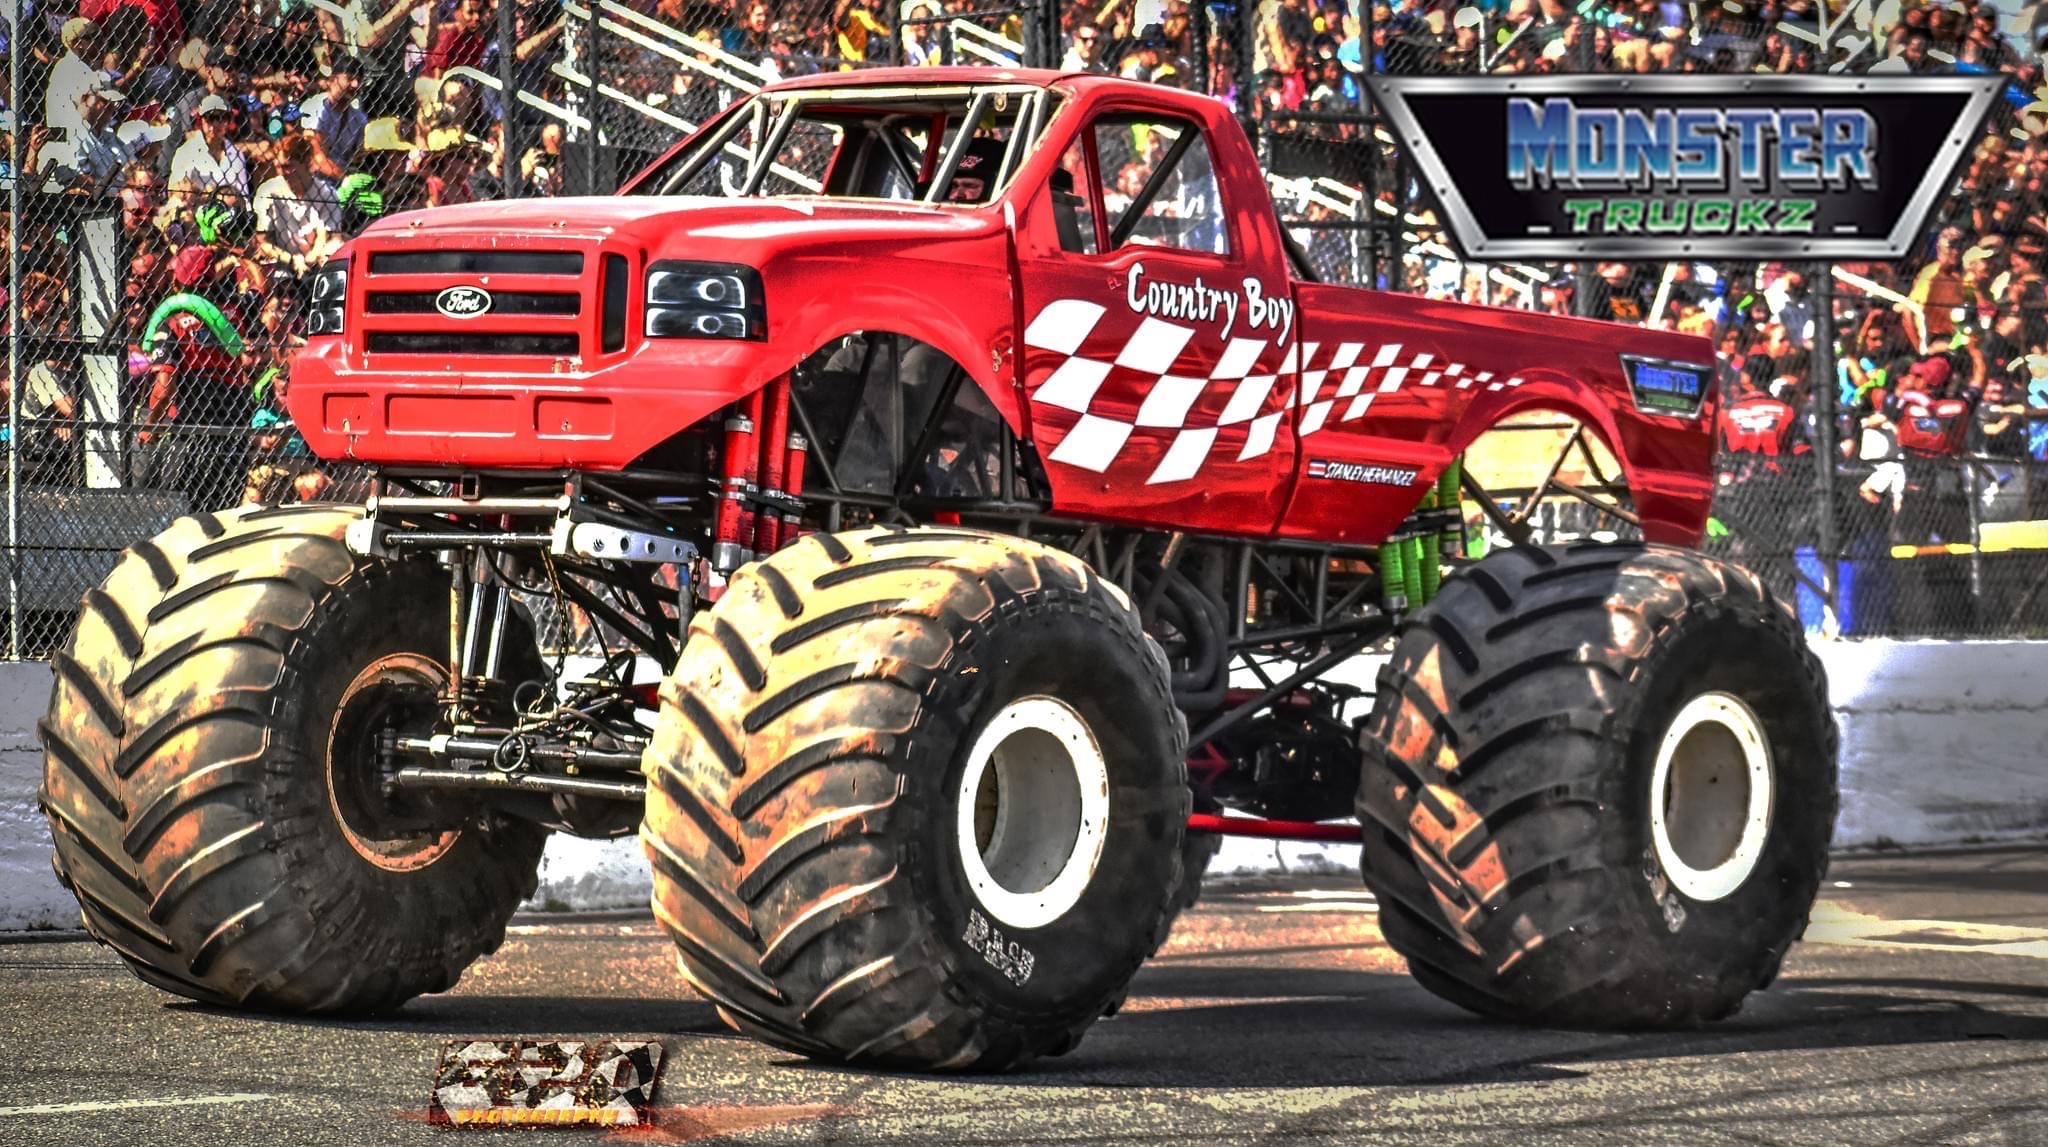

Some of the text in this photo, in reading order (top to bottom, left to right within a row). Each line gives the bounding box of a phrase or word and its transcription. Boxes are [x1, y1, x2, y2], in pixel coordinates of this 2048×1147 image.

[446, 290, 481, 312] Ford
[1127, 261, 1294, 348] Country Boy
